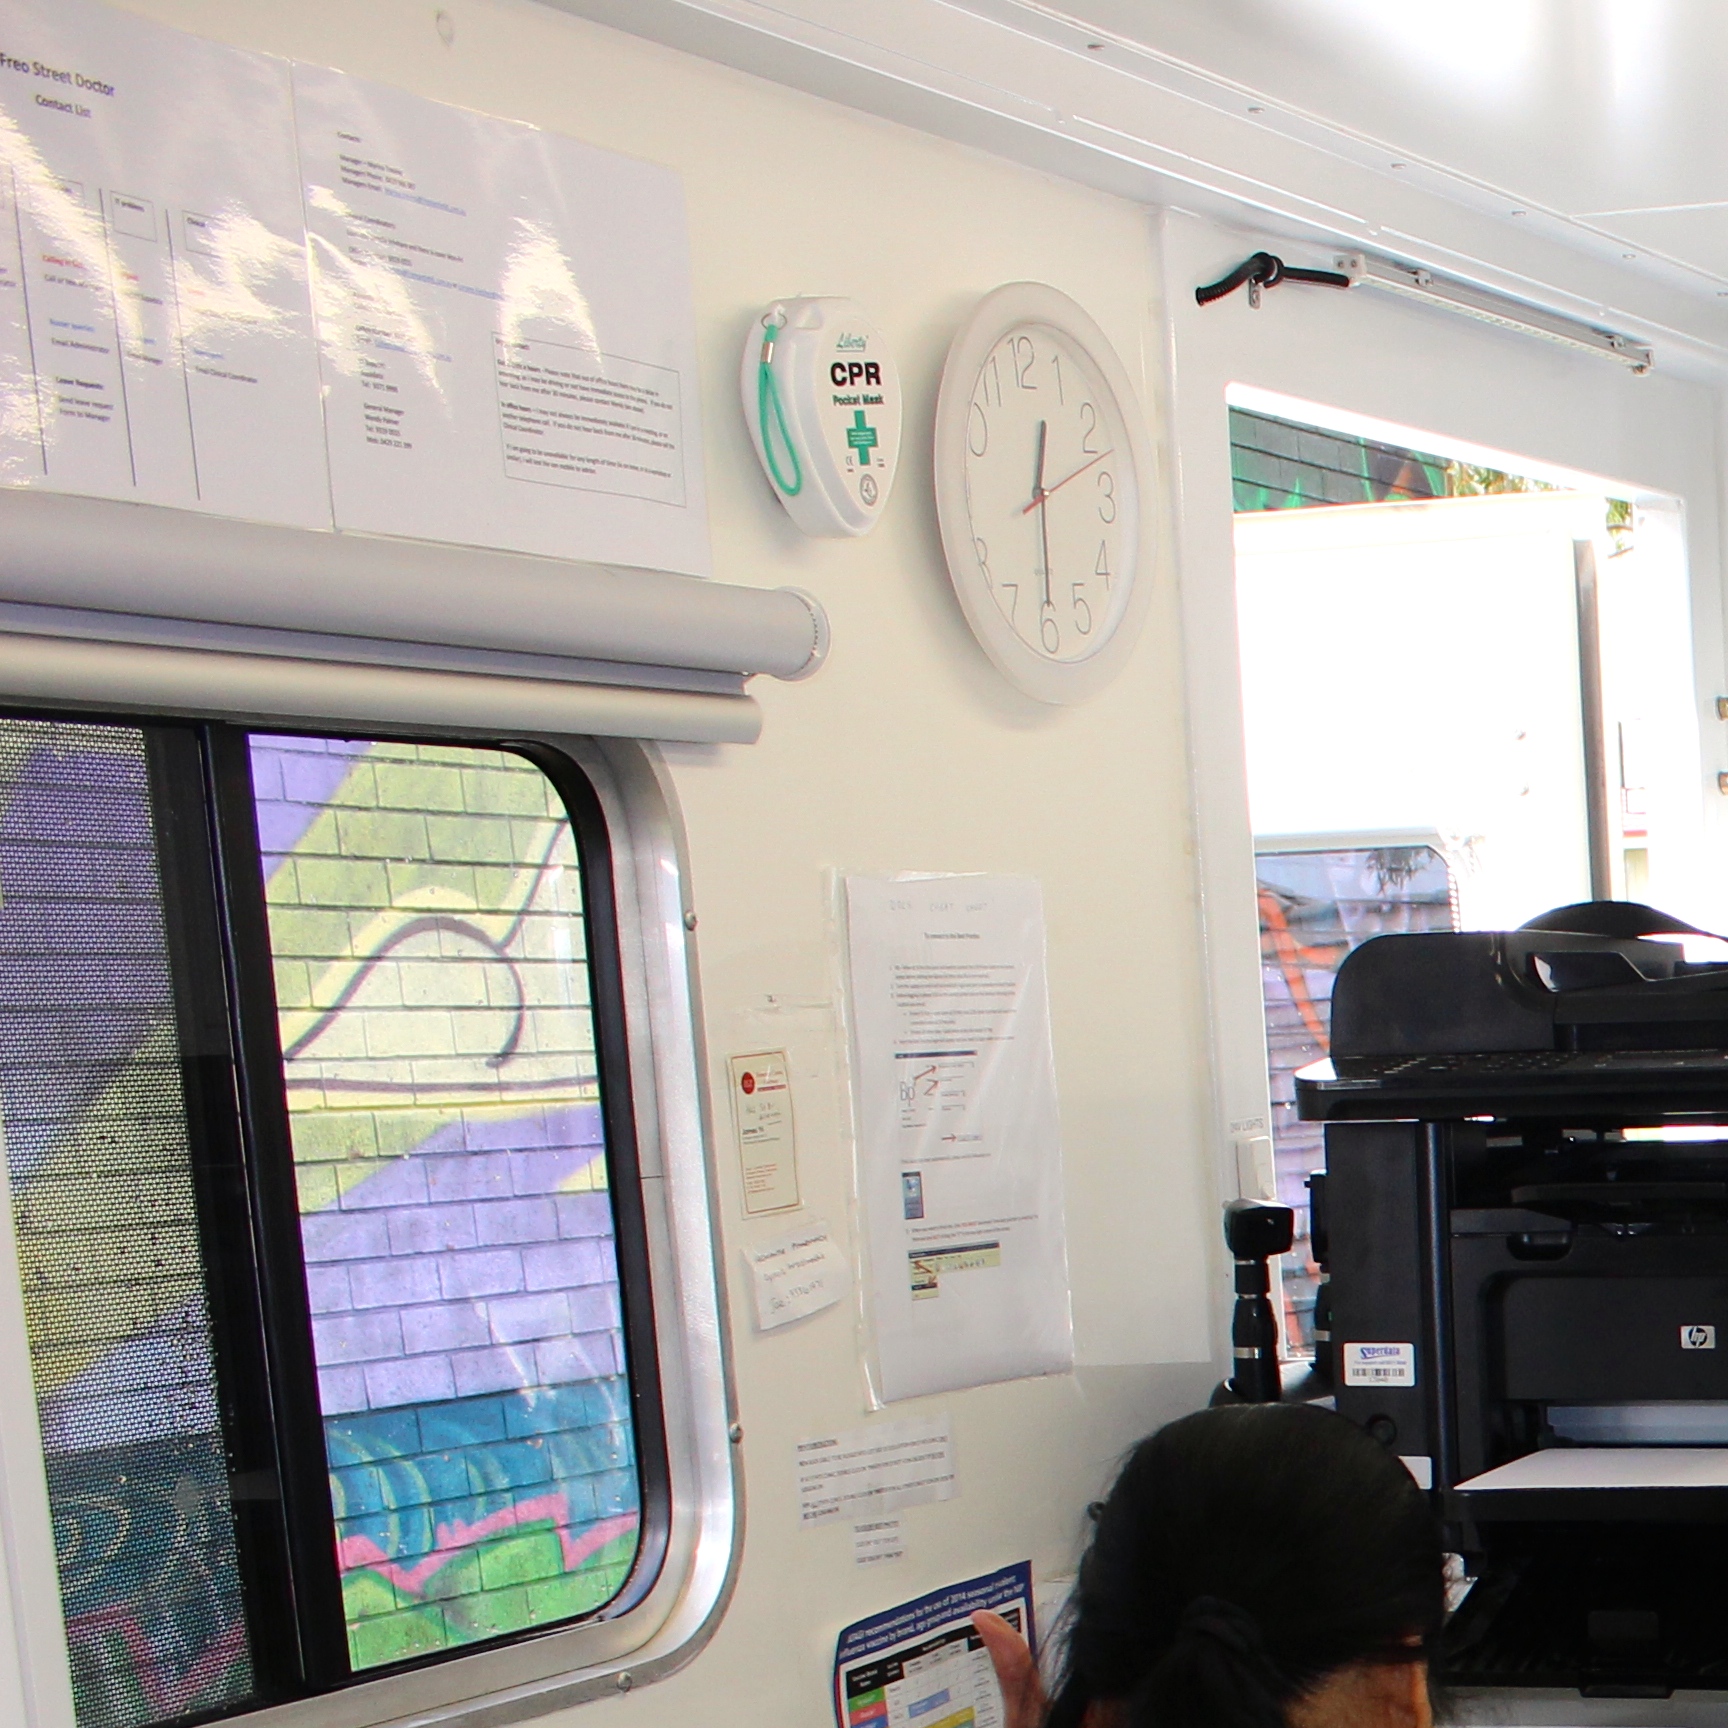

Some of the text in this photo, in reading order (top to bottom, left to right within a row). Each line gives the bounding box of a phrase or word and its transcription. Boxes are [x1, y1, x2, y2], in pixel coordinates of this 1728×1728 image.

[0, 53, 115, 96] Freo Street Doctor
[36, 94, 91, 117] Contact List
[831, 362, 882, 386] CPR
[983, 356, 1004, 407] 11
[1007, 336, 1038, 391] 12
[1052, 355, 1063, 405] 1
[833, 394, 884, 406] Pocket Mask
[1080, 406, 1098, 454] 2
[1098, 471, 1116, 524] 3
[1095, 540, 1111, 591] 4
[1002, 584, 1019, 632] 7
[1040, 601, 1060, 654] 6
[1072, 584, 1091, 635] 5
[967, 1583, 993, 1599] seasonal
